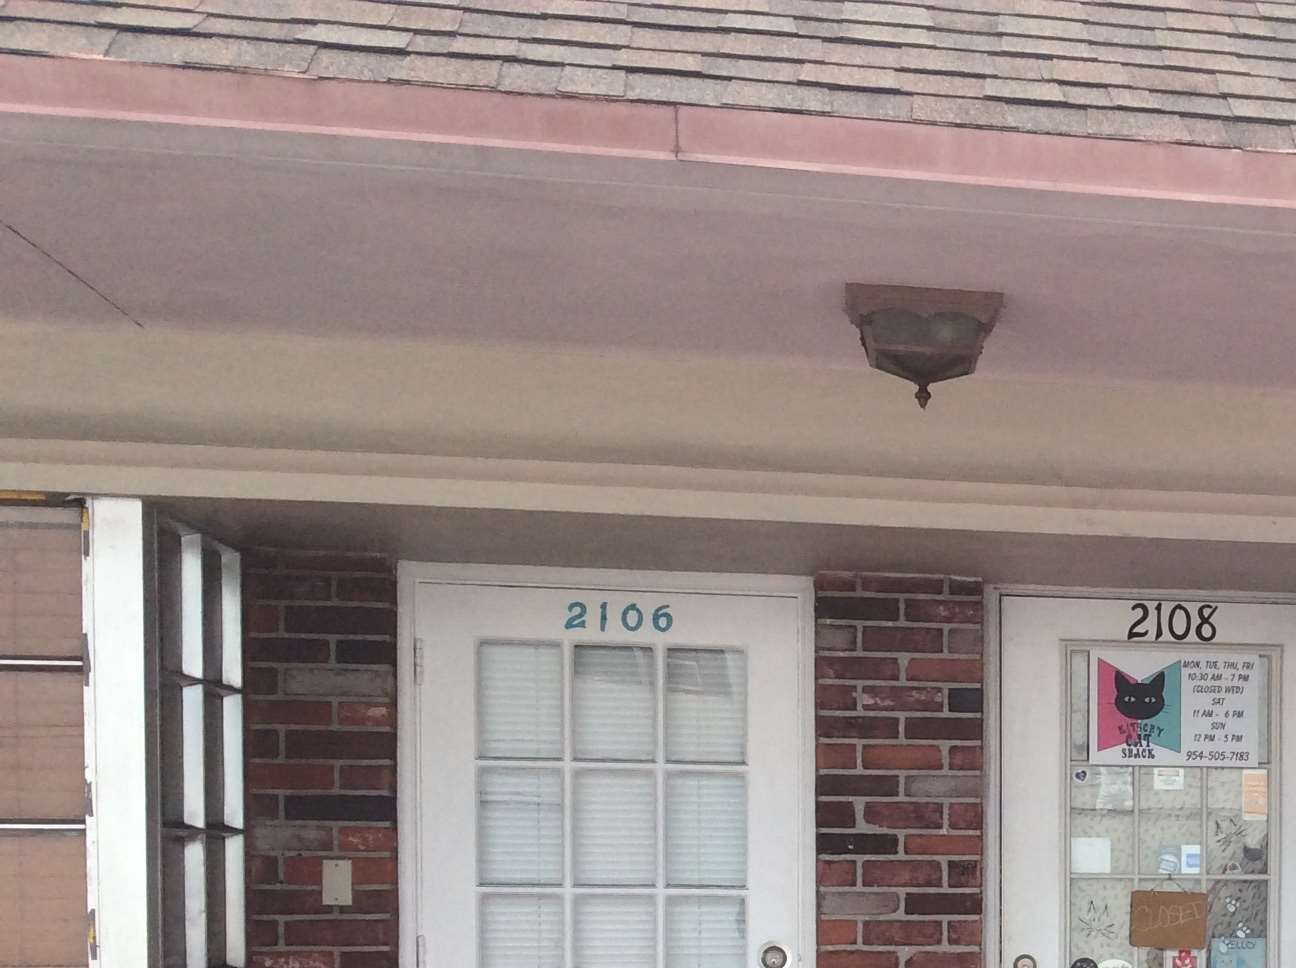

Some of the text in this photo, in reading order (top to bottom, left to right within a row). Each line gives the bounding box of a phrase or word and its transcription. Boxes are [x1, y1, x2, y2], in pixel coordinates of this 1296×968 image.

[564, 601, 673, 632] 2106
[1127, 602, 1218, 642] 2108
[1242, 662, 1255, 670] FRI
[1211, 673, 1223, 681] AM
[1238, 673, 1250, 681] PM
[1211, 697, 1225, 706] SAT
[1201, 709, 1214, 718] AM
[1224, 710, 1230, 718] 6
[1232, 710, 1244, 718] PM
[1211, 721, 1226, 730] SUN
[1126, 733, 1152, 747] CAT
[1204, 734, 1215, 742] PM
[1231, 734, 1243, 742] PM
[1122, 748, 1155, 759] SHACK
[1186, 750, 1249, 761] 954-505-7183
